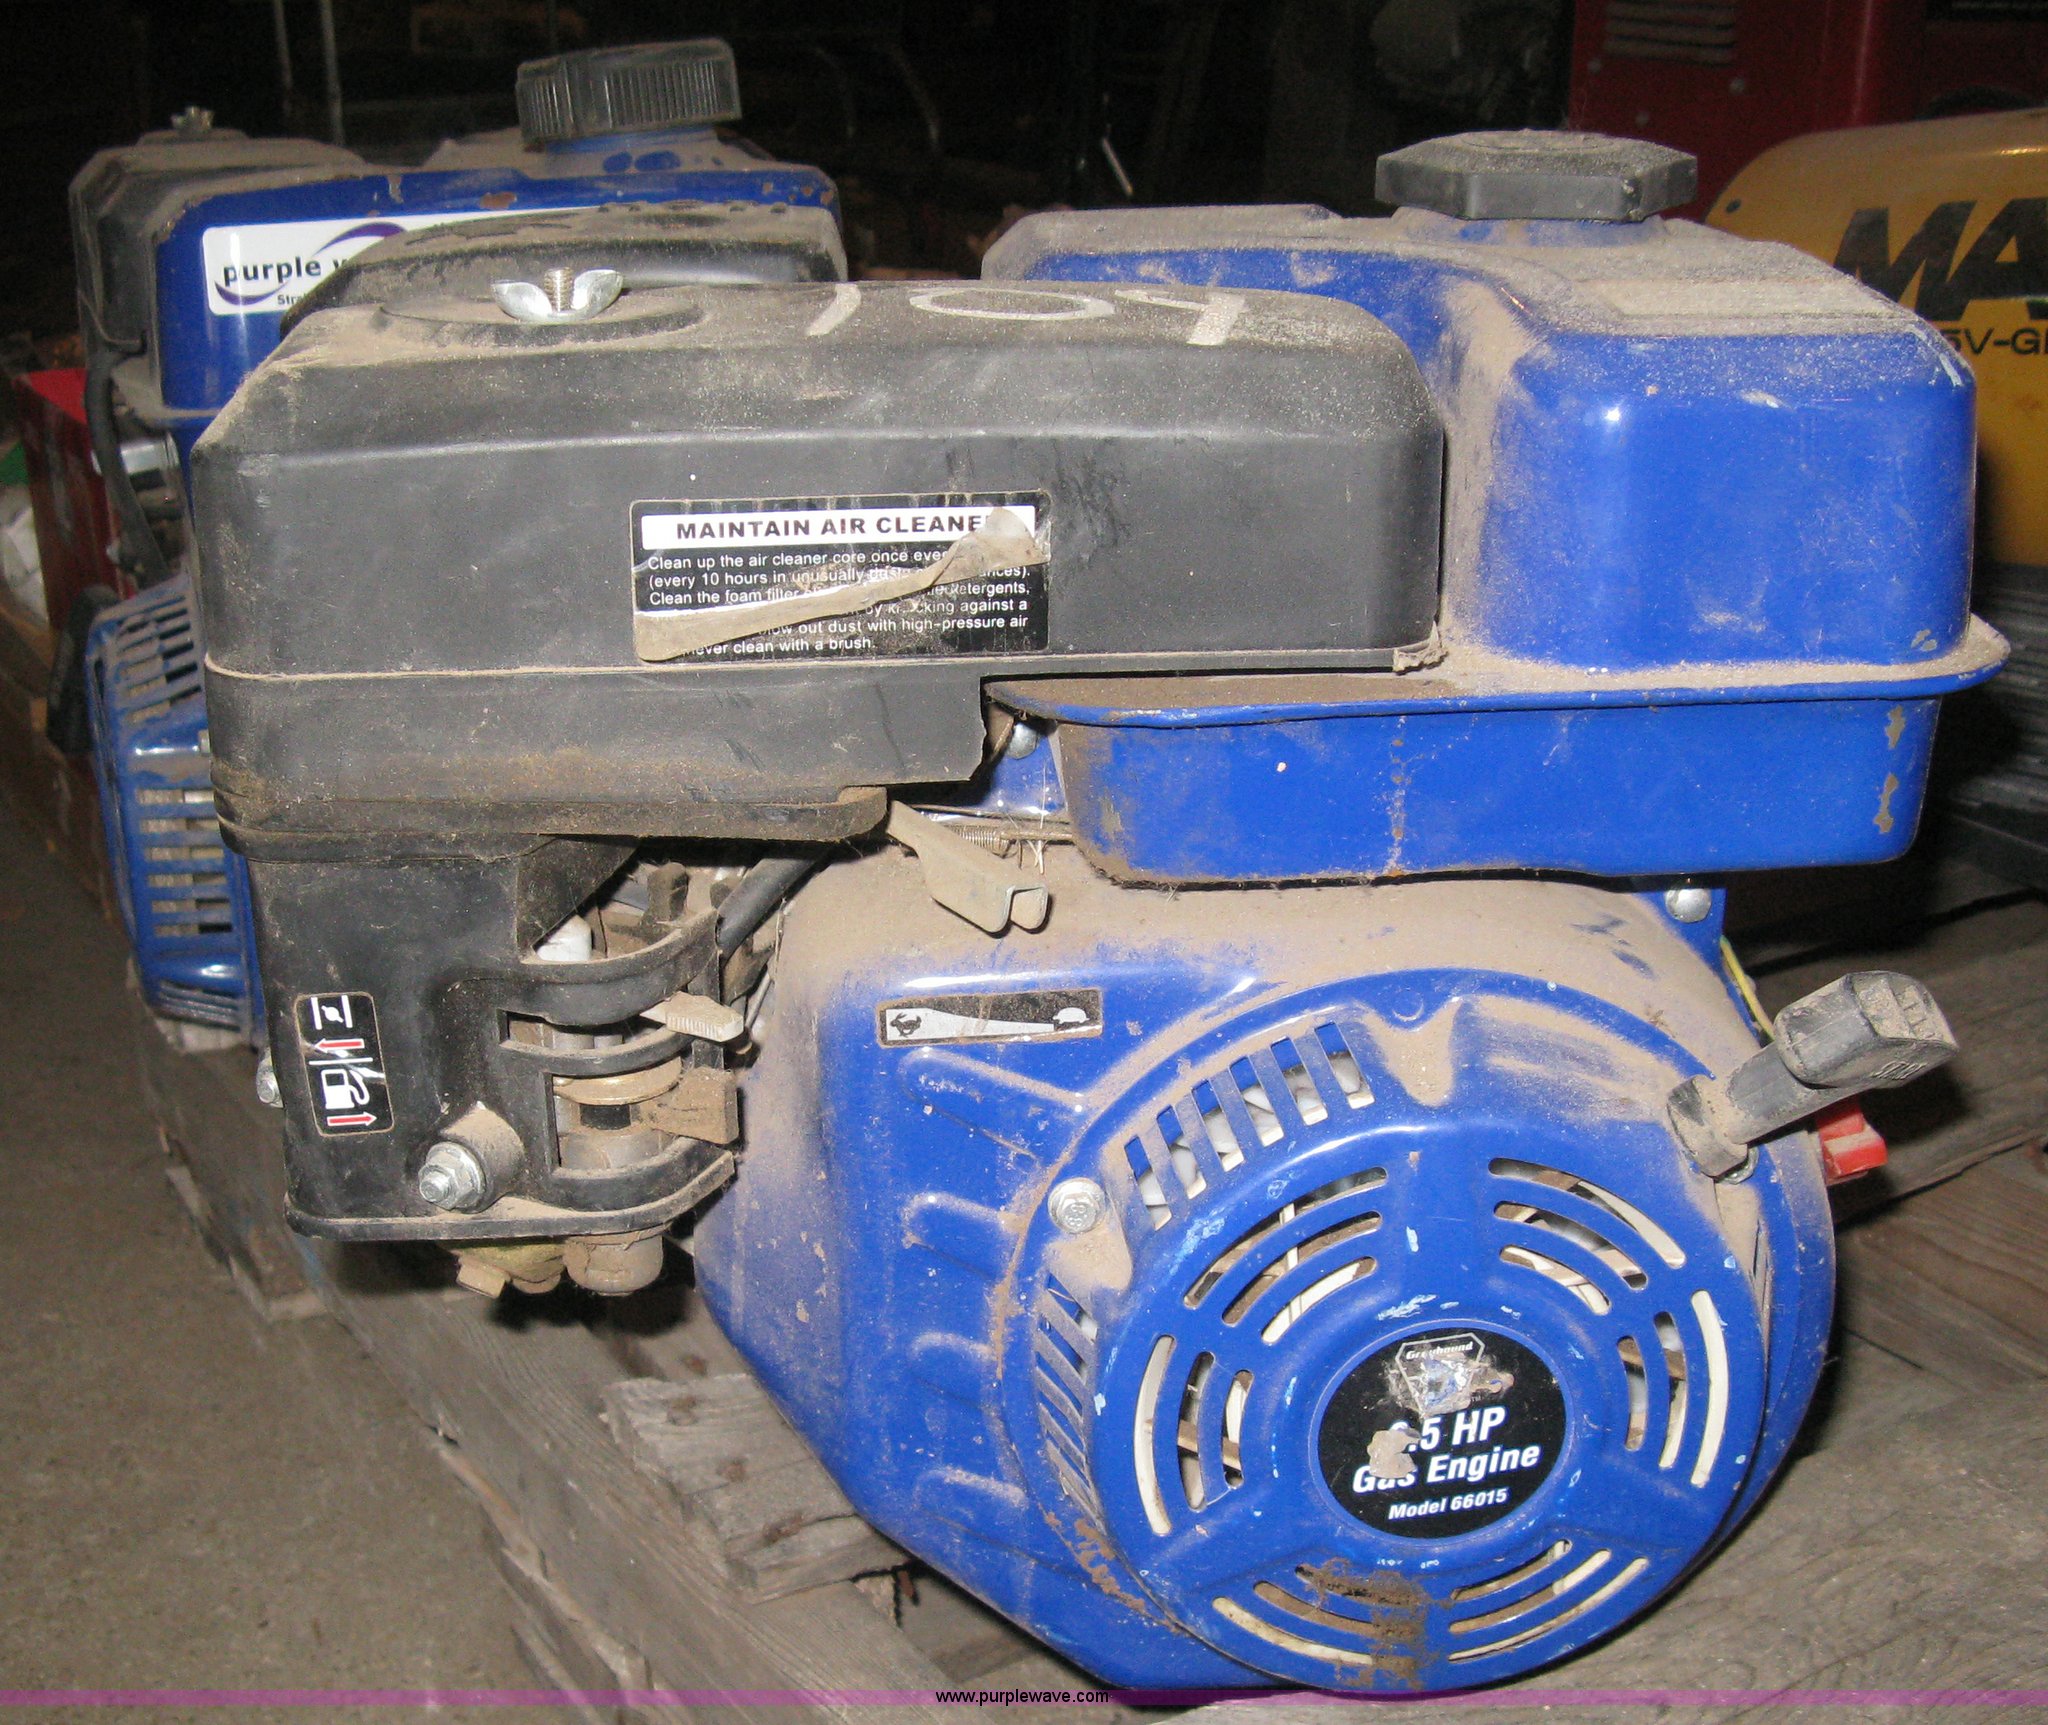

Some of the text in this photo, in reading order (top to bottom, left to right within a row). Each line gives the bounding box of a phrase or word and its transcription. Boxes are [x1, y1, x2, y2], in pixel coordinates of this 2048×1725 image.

[223, 256, 322, 287] purple
[677, 514, 988, 540] MAINTAIN AIR CLEANE
[648, 556, 692, 570] Clean
[697, 558, 715, 571] up
[720, 554, 744, 568] the
[749, 554, 769, 567] air
[773, 552, 828, 566] cleaner
[832, 551, 866, 564] core
[871, 551, 908, 563] once
[649, 574, 696, 589] (every
[702, 573, 719, 586] 10
[724, 571, 768, 585] hours
[773, 570, 786, 583] in
[792, 567, 864, 584] unusually
[649, 591, 693, 605] Clean
[697, 590, 720, 604] the
[724, 590, 762, 603] foam
[960, 599, 1015, 615] against
[1018, 600, 1028, 611] a
[798, 621, 823, 634] out
[828, 619, 862, 633] dust
[867, 617, 897, 631] with
[901, 614, 1005, 633] high-pressure
[1009, 615, 1029, 628] air
[733, 640, 774, 654] clean
[779, 638, 809, 652] with
[814, 640, 824, 651] a
[829, 636, 877, 651] brush.
[1452, 1406, 1507, 1446] HP
[1426, 1444, 1542, 1483] Engine
[1388, 1487, 1509, 1520] Model 66015
